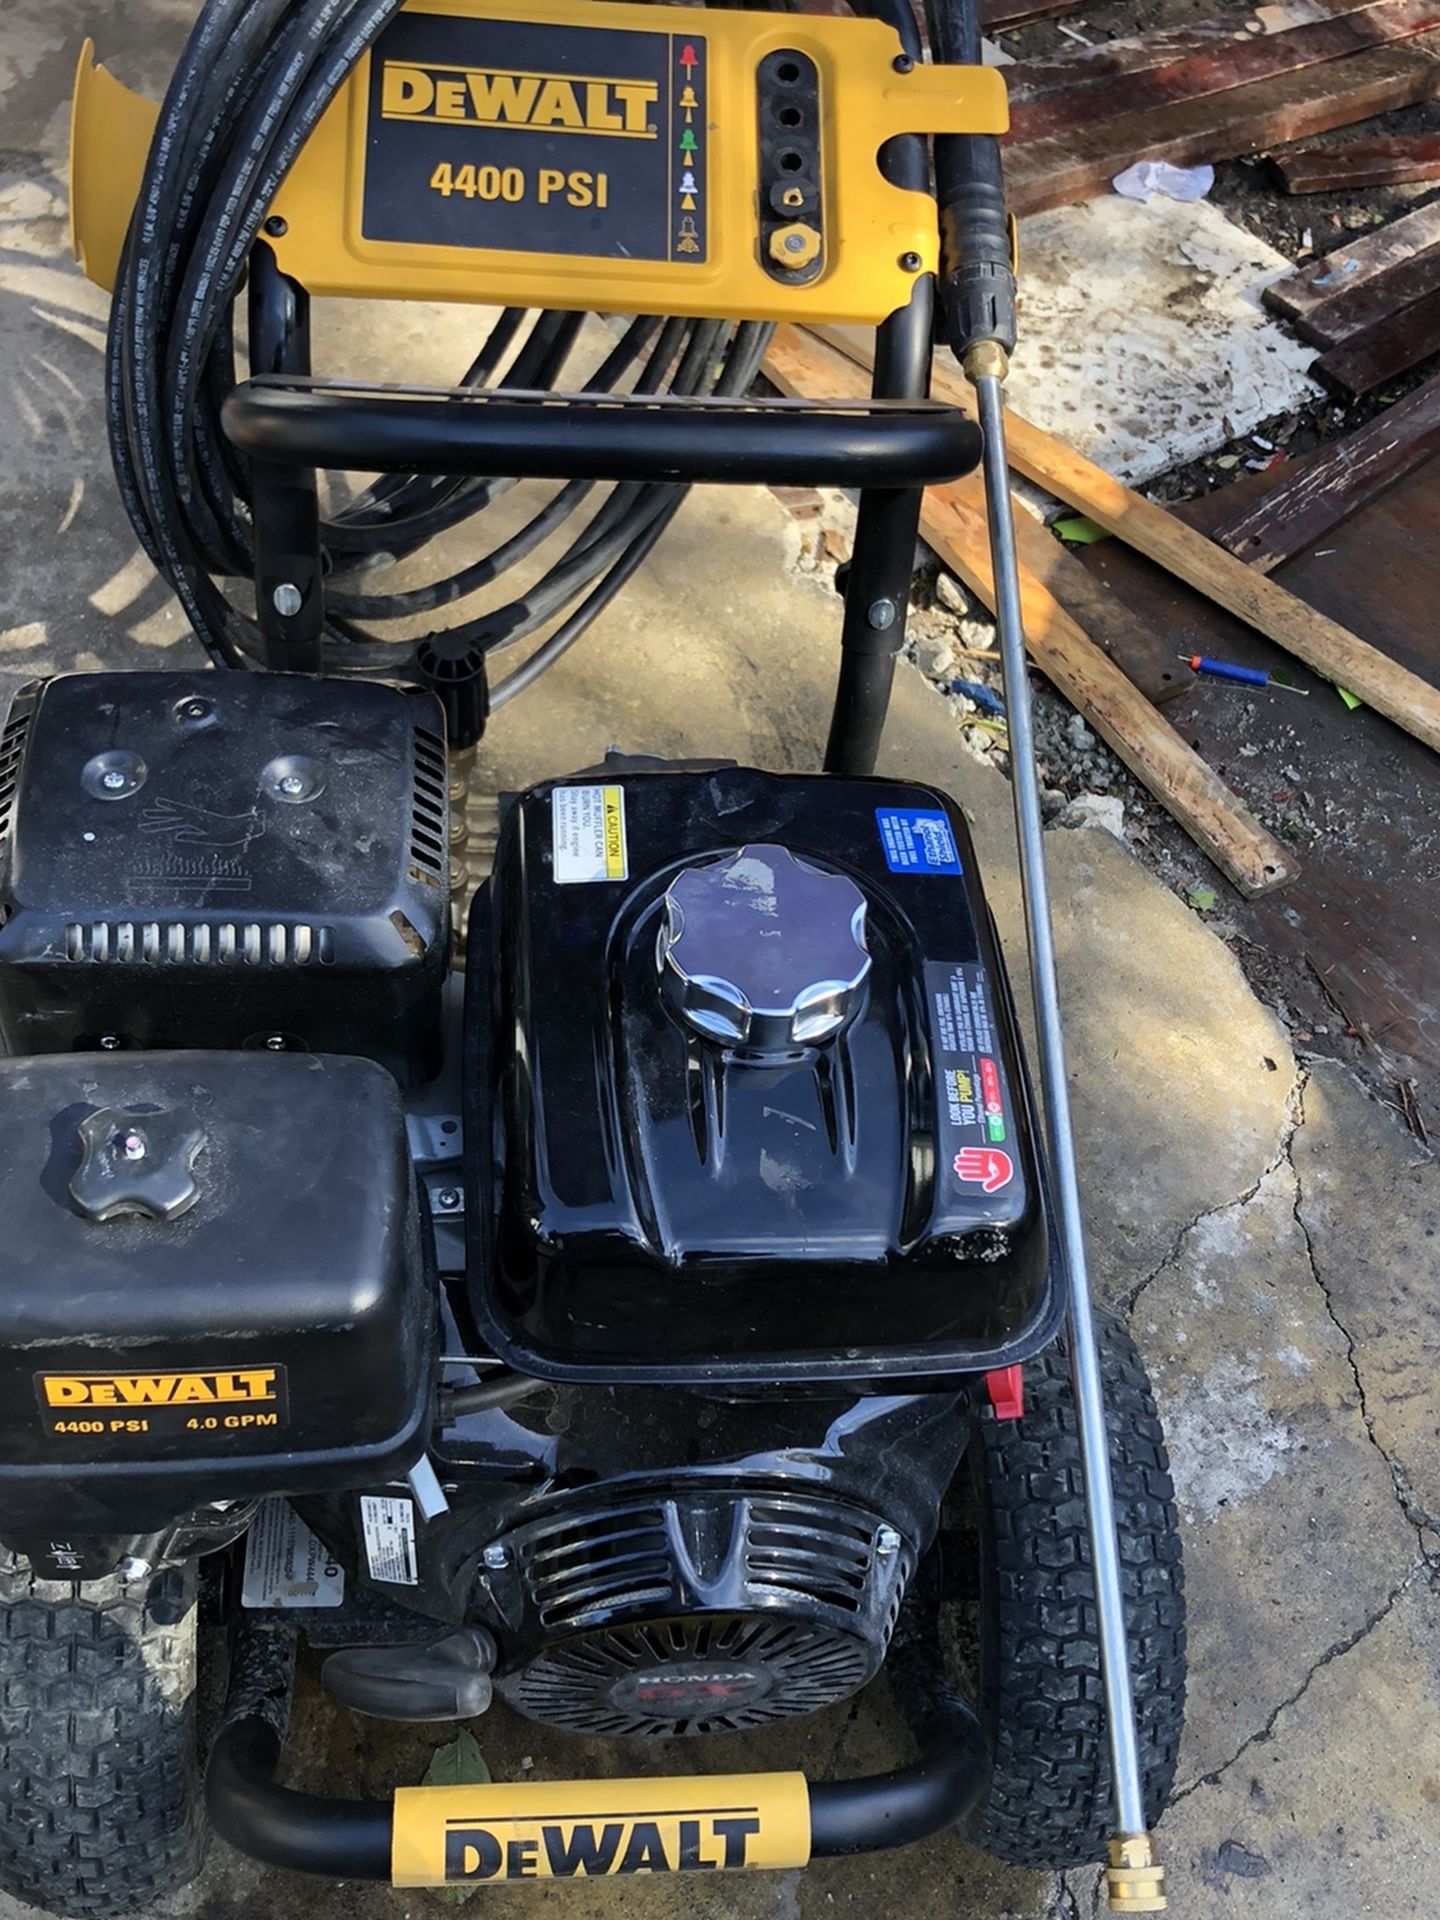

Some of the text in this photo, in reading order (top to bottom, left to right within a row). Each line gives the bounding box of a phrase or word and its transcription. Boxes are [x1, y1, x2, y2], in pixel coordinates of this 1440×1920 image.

[382, 66, 658, 132] DEWALT
[430, 162, 608, 208] 4400 PSI
[593, 804, 603, 839] MUFFLER
[607, 815, 620, 857] CAUTION
[595, 841, 604, 857] CAN
[922, 825, 939, 863] Ethanol
[944, 1069, 962, 1126] LOOK BEFORE
[956, 1069, 974, 1104] PUMP!
[960, 1104, 976, 1126] YOU
[44, 1372, 276, 1404] DEWALT
[54, 1413, 277, 1434] 4400 PSI 4.0 GPM
[637, 1672, 756, 1684] HONDA
[444, 1817, 760, 1881] DEWALT
